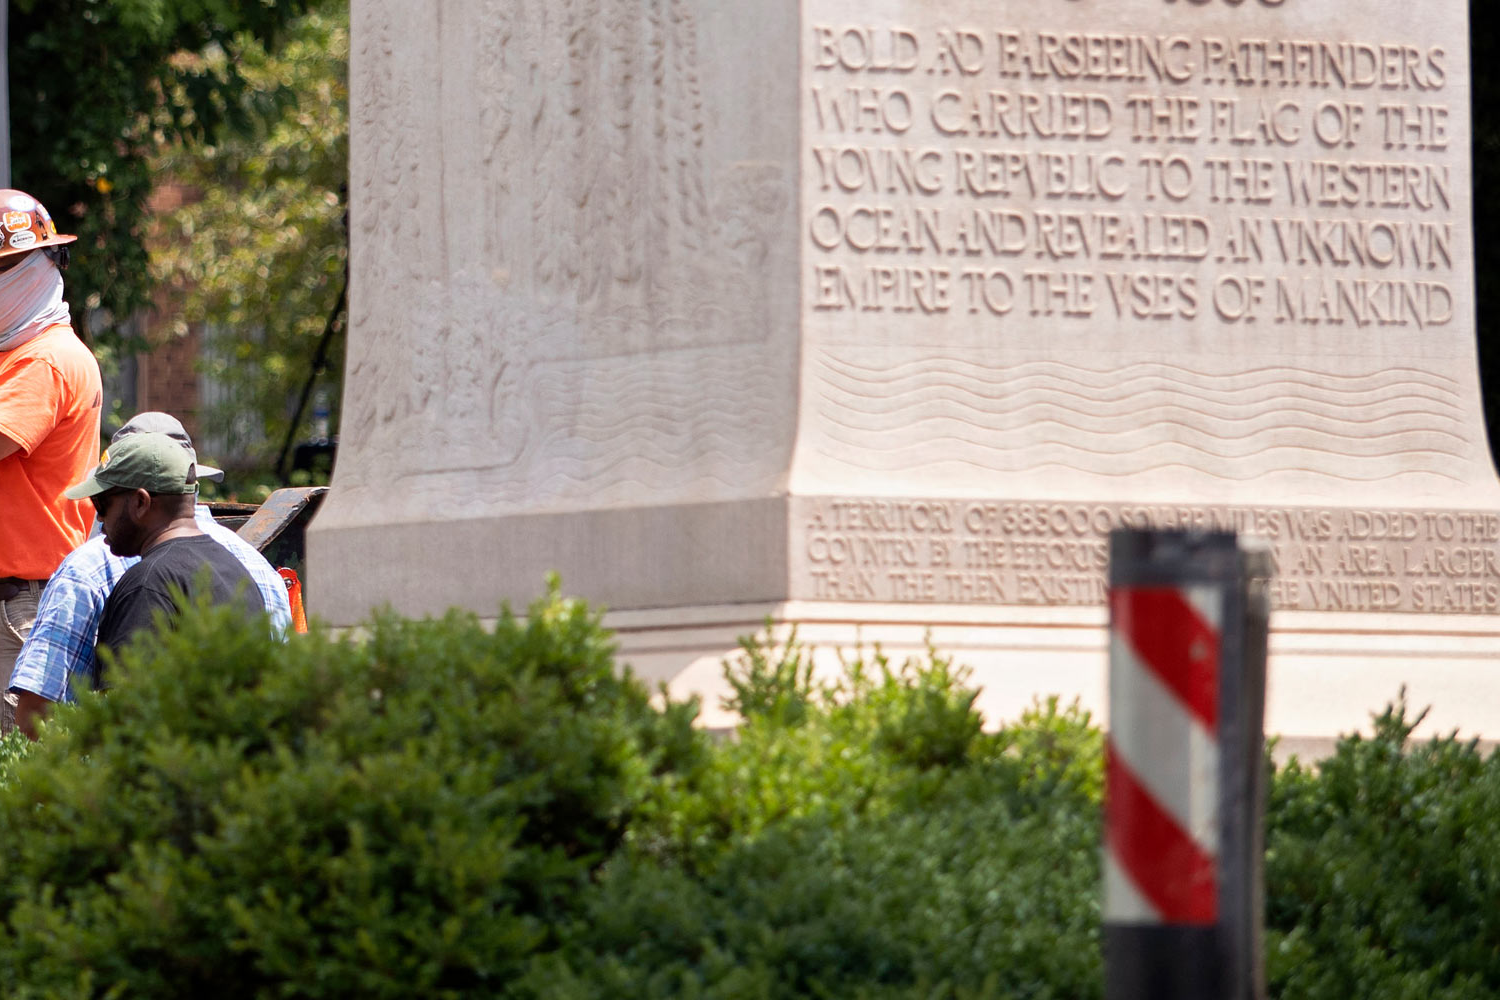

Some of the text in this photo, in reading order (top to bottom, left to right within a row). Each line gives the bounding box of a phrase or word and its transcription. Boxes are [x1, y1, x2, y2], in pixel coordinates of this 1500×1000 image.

[813, 25, 918, 73] BOLD
[997, 30, 1195, 84] FARSEEING
[1201, 38, 1445, 90] PATHFINDERS
[812, 86, 1449, 151] WHO CARRIED THE FLAG OF THE
[812, 146, 1451, 211] YOVNG REPVBLIC TO THE WESTERN
[810, 205, 1452, 270] OCEAN AND REVEALED AN VNKNOWN
[813, 266, 1452, 329] EMPIRE TO THE VSES OF MANKIND
[807, 502, 828, 530] A
[831, 500, 958, 533] TERRITORY
[965, 503, 997, 534] OF
[1283, 508, 1331, 541] WAS
[1337, 510, 1418, 542] ADDED
[1422, 512, 1454, 543] TO
[1457, 512, 1499, 544] THE
[808, 536, 922, 567] COVNTRY
[929, 538, 956, 568] BY
[963, 538, 1004, 569] THE
[1011, 540, 1110, 571] EFFORTS
[1291, 545, 1324, 576] AN
[1332, 545, 1395, 576] AREA
[1403, 547, 1500, 579] LARGER
[810, 570, 876, 599] THAN
[887, 572, 935, 601] THE
[945, 573, 1005, 601] THEN
[1306, 580, 1400, 610] VNITED
[1412, 582, 1499, 612] STATES
